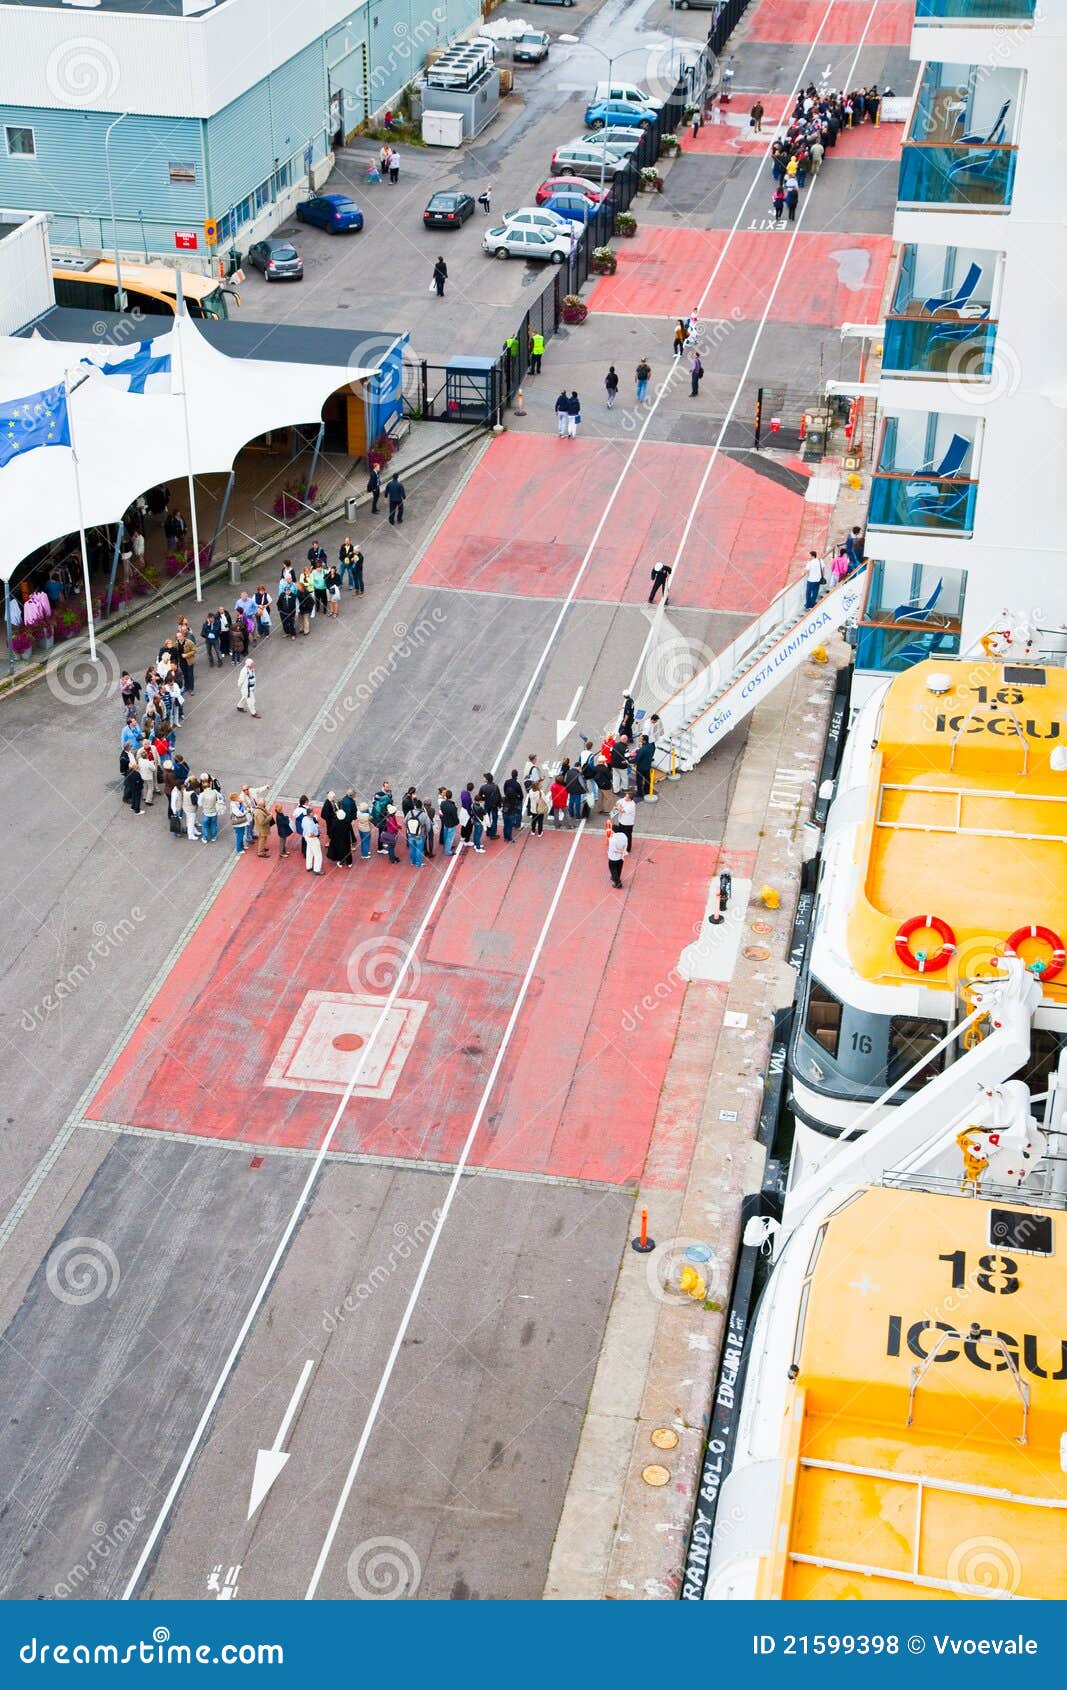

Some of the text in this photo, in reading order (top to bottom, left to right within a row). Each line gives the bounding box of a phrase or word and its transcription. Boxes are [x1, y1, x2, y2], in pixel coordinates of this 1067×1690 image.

[741, 611, 832, 699] COSTA LUMINOSA
[969, 686, 1024, 705] 16
[708, 709, 733, 735] Costa
[936, 714, 1060, 739] ICGU
[851, 1031, 873, 1055] 16
[938, 1250, 1019, 1295] 18
[887, 1315, 1067, 1380] ICGU
